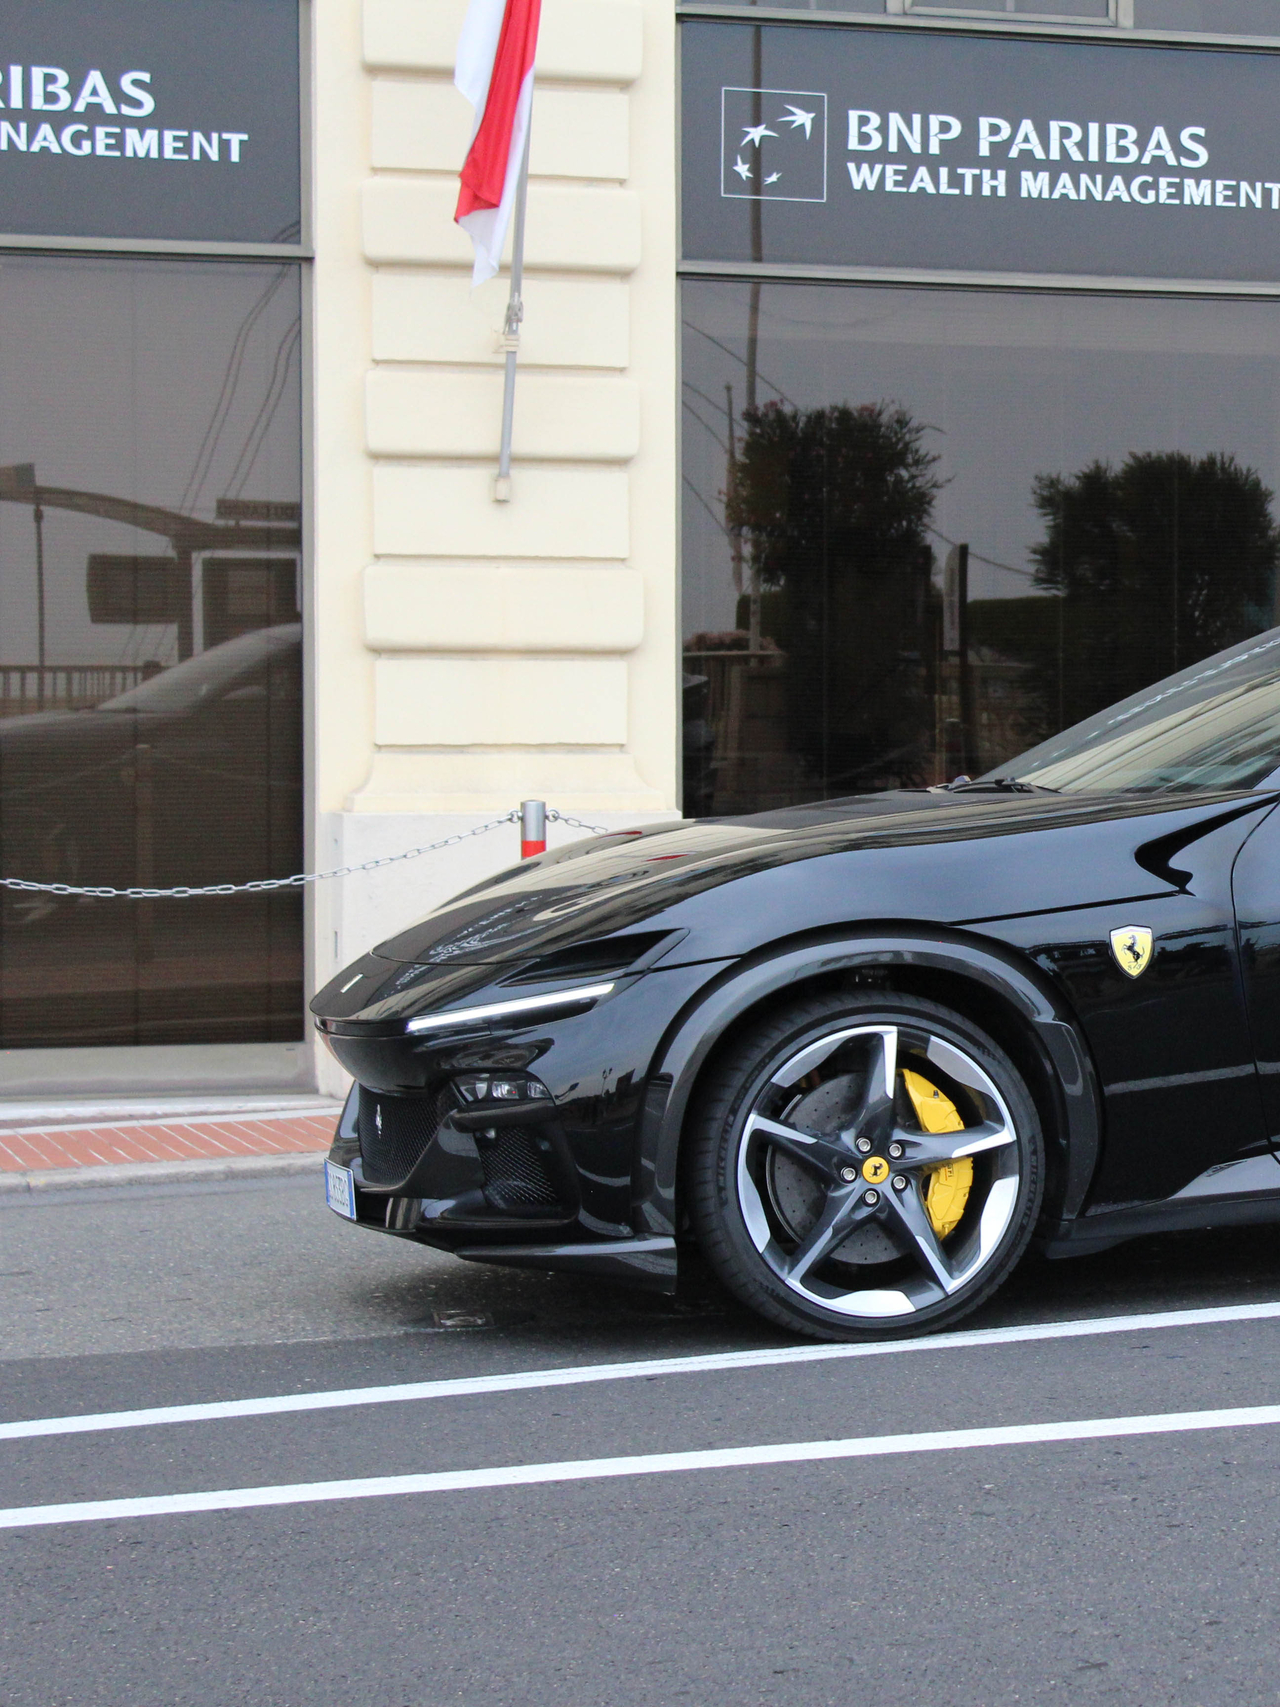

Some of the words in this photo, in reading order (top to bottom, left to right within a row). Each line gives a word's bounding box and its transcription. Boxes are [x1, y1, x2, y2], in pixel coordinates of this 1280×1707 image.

[847, 109, 962, 155] BNP
[978, 116, 1209, 169] PARIBAS
[846, 161, 1007, 197] WEALTH
